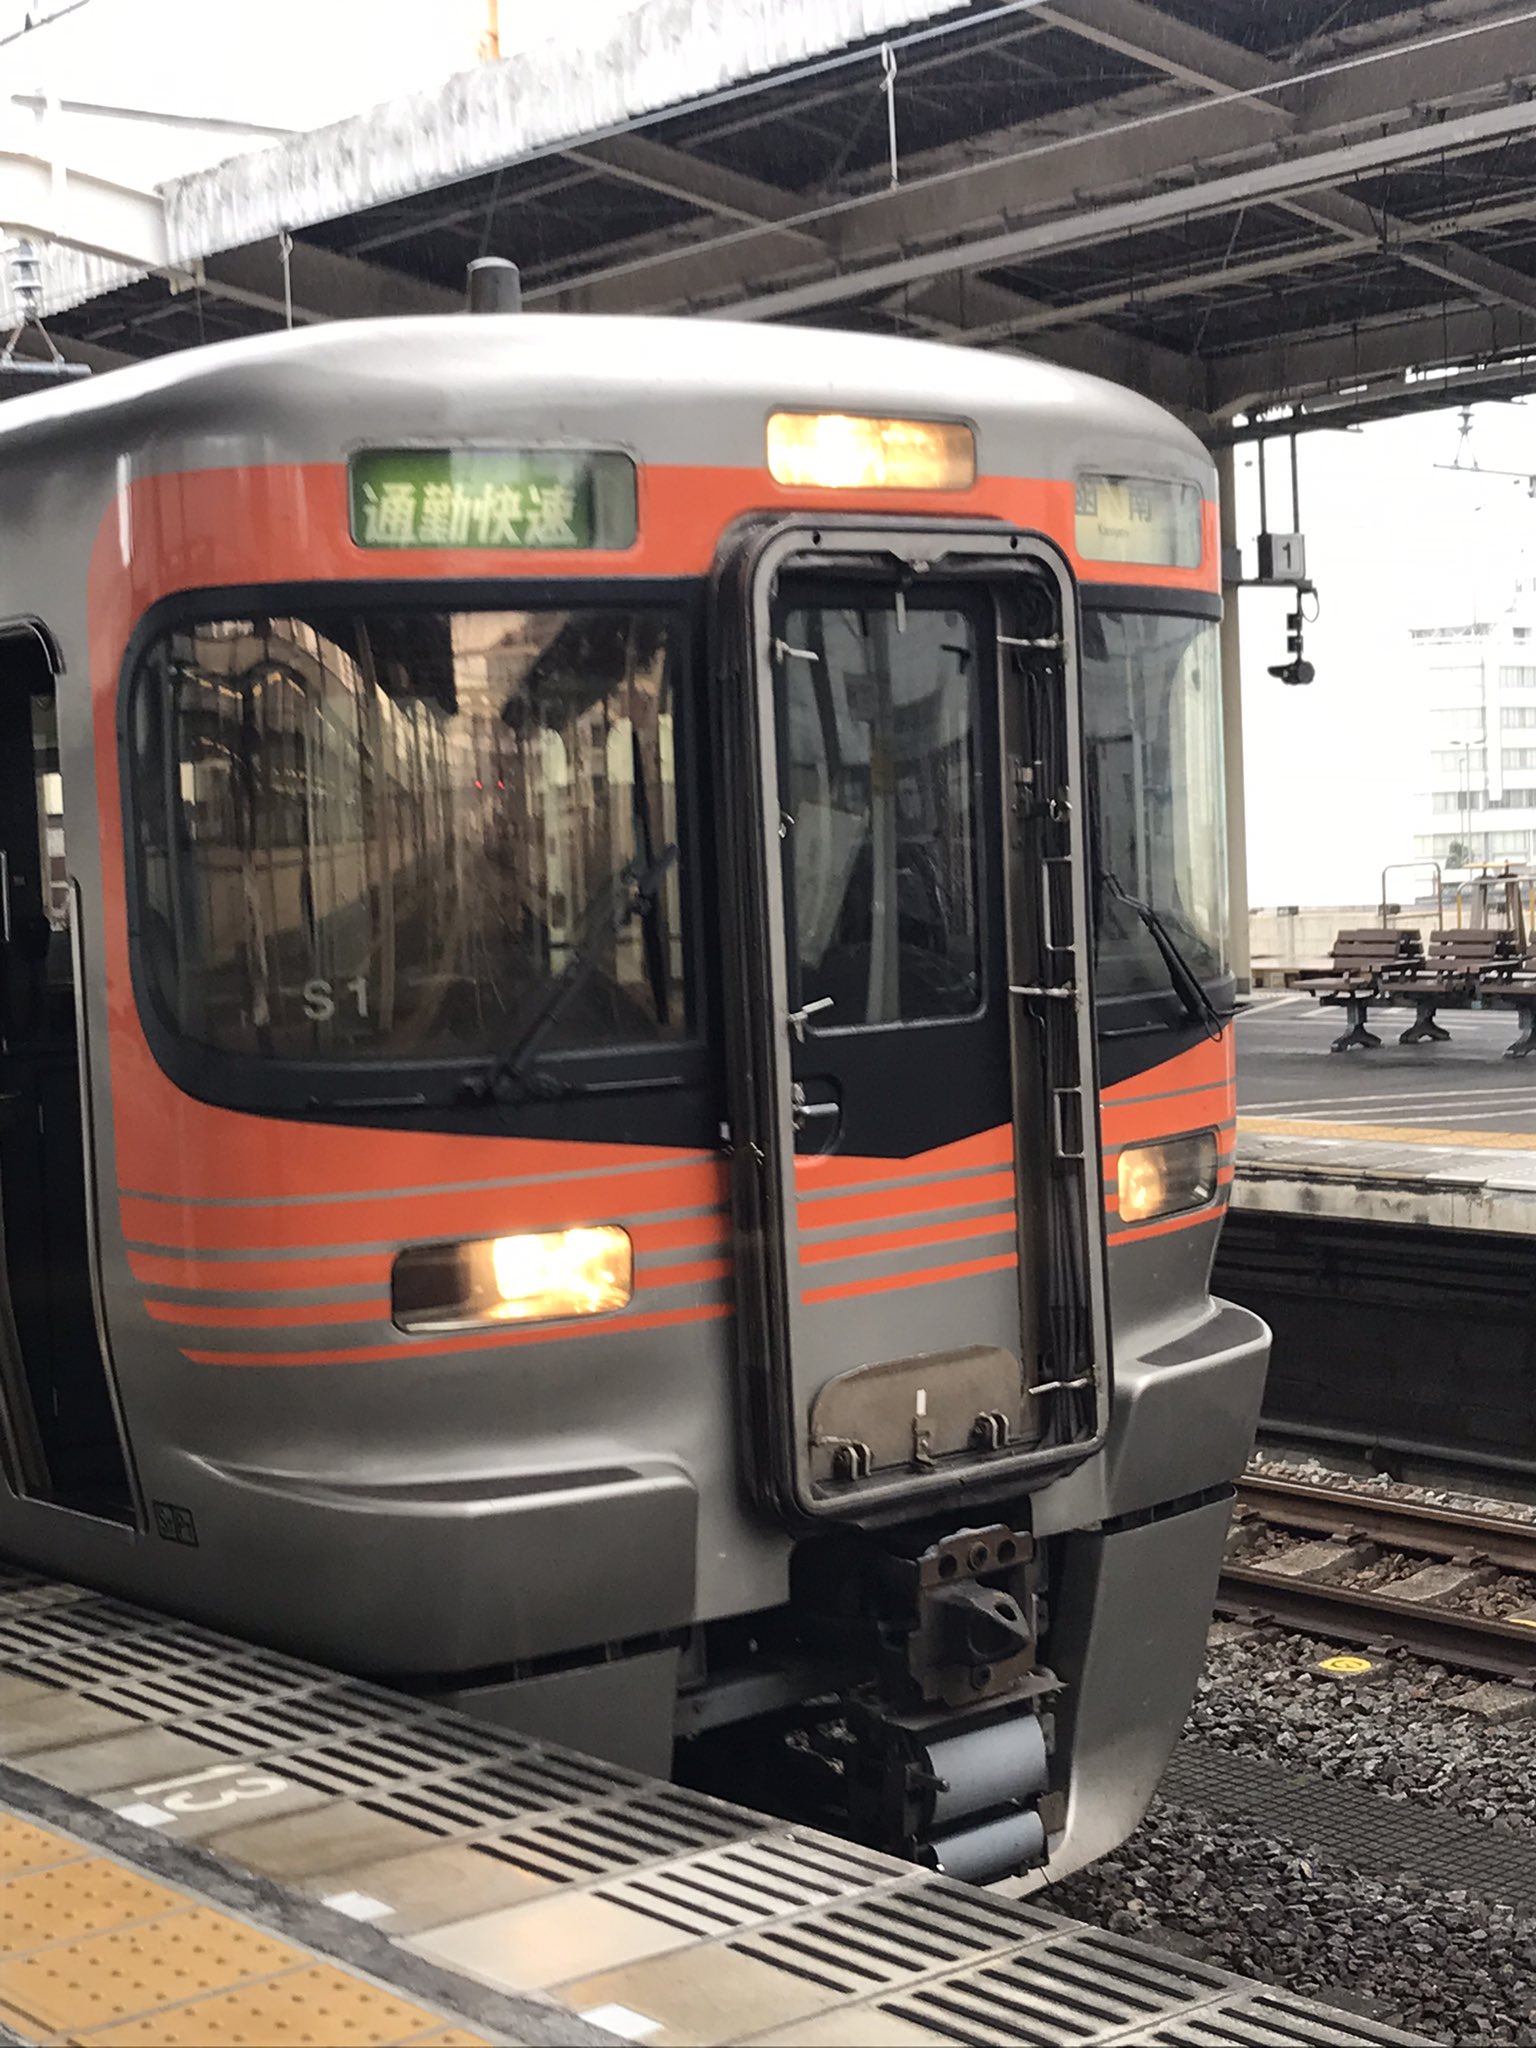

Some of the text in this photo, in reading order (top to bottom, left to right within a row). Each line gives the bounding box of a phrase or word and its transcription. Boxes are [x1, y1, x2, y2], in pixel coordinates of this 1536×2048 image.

[362, 482, 577, 545] 通勤快速
[1281, 541, 1292, 570] 1
[303, 976, 369, 1021] S1
[133, 1763, 289, 1813] 13
